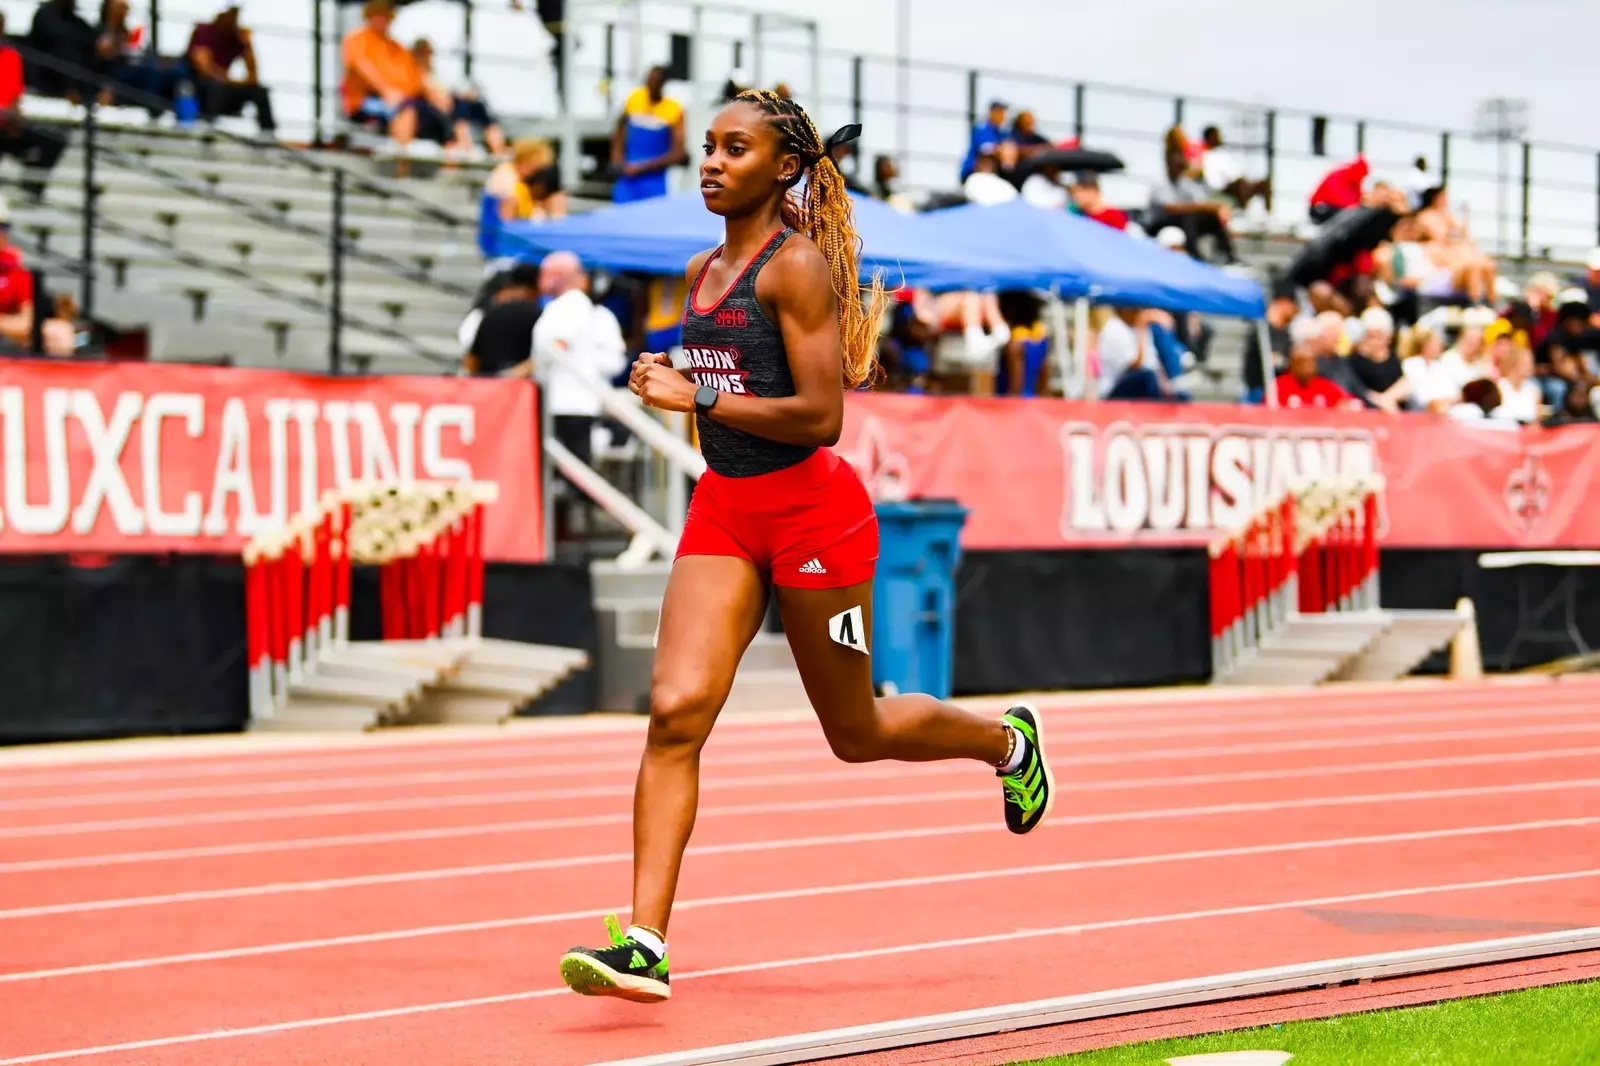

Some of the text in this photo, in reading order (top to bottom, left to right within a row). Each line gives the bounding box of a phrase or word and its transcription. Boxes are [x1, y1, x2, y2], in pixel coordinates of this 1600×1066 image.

[715, 308, 747, 328] SBC
[692, 372, 747, 394] AJUNS
[0, 385, 475, 537] UXCAJUNS
